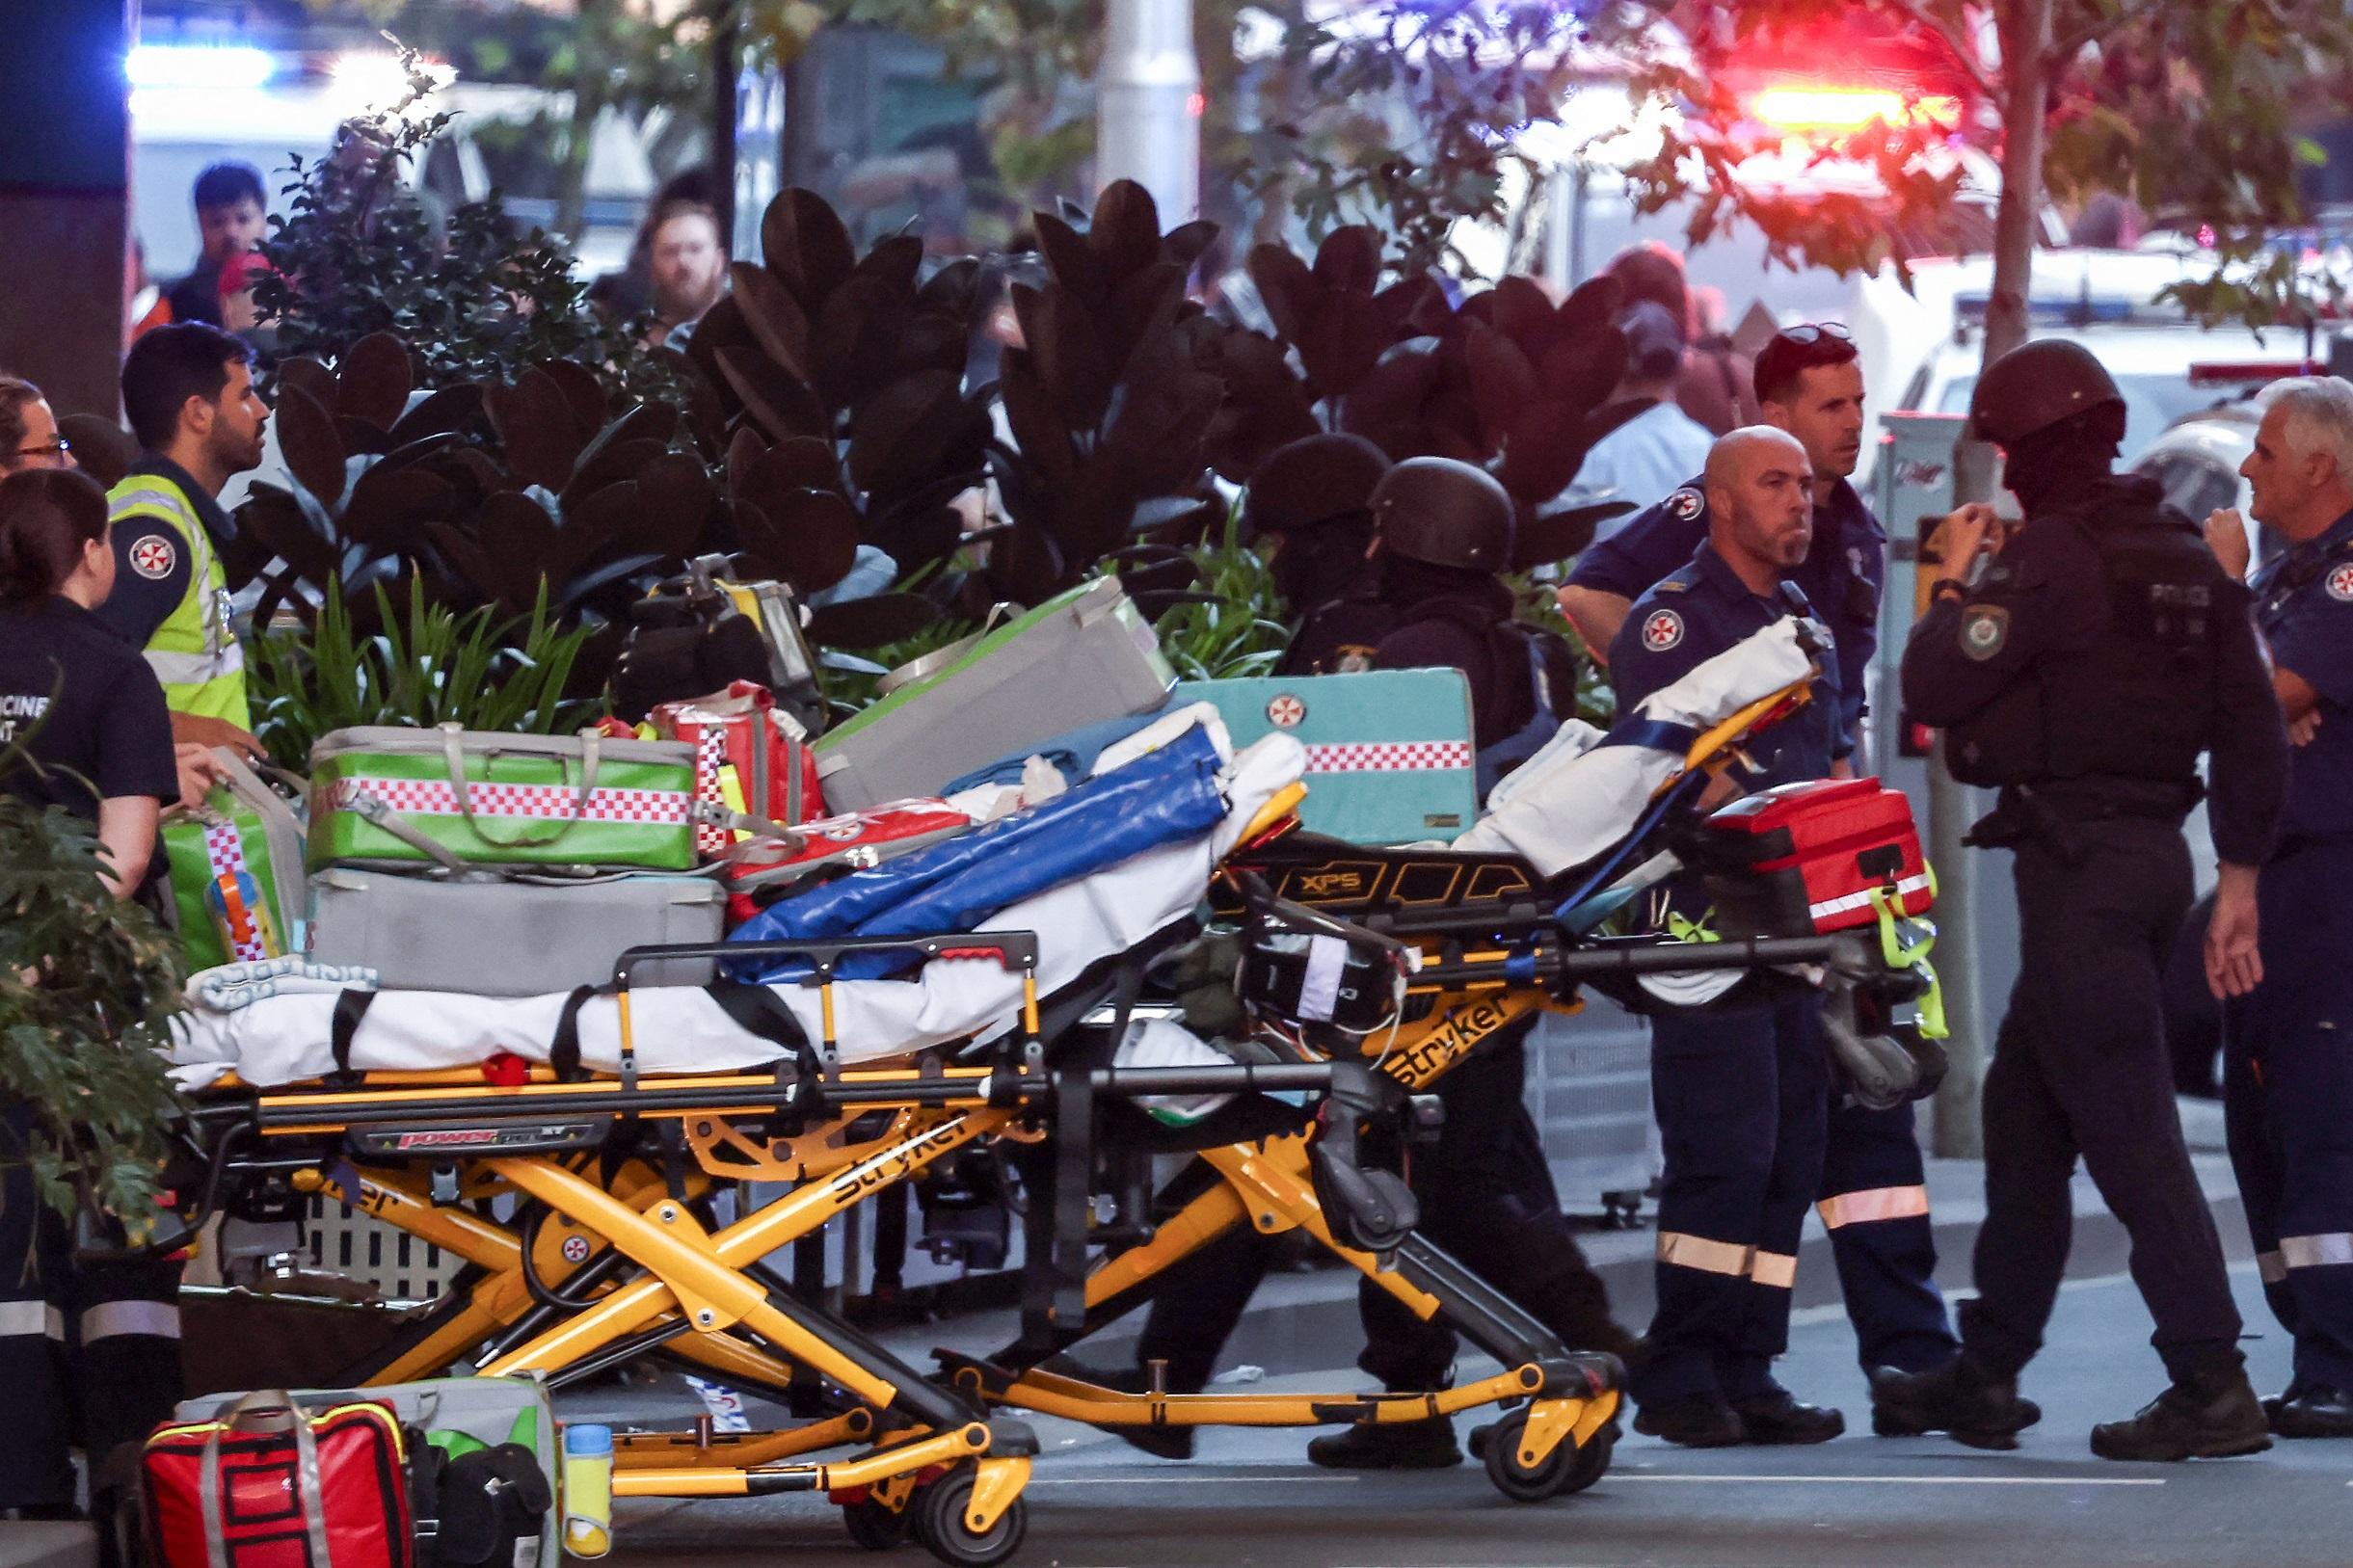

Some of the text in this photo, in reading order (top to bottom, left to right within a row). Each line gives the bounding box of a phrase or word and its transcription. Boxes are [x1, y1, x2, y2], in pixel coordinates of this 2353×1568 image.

[0, 695, 50, 719] CINE
[1300, 872, 1361, 894] XPS
[1381, 992, 1508, 1085] Stryker
[832, 1108, 970, 1204] Stryker
